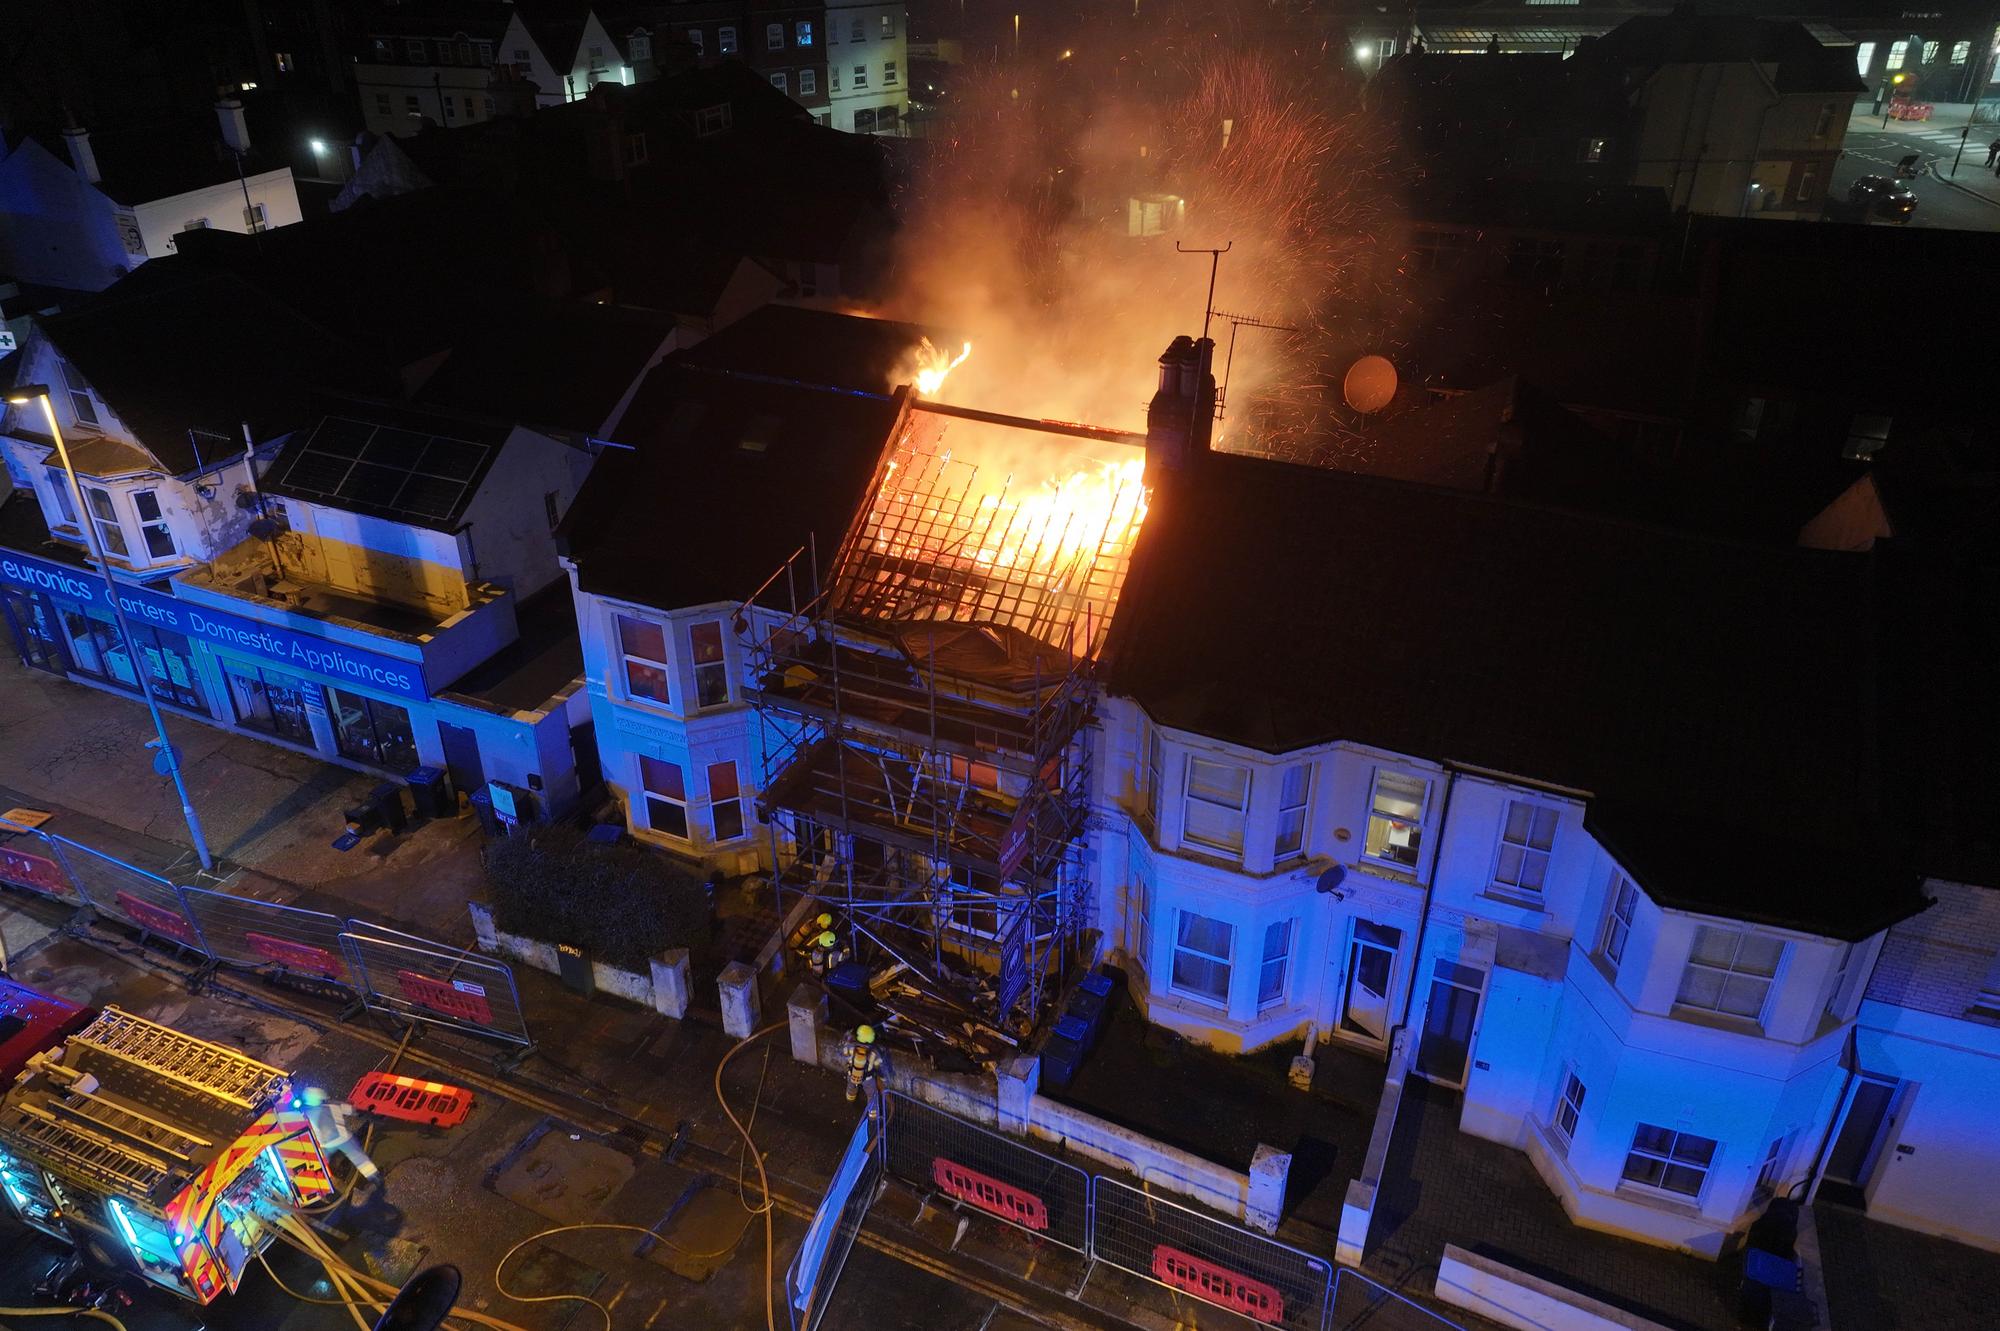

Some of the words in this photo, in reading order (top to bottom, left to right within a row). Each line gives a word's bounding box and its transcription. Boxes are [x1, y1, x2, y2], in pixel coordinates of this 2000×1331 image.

[2, 560, 94, 600] euronics
[104, 588, 178, 625] Carters
[189, 611, 287, 656] Domestic
[291, 640, 411, 690] Appliances
